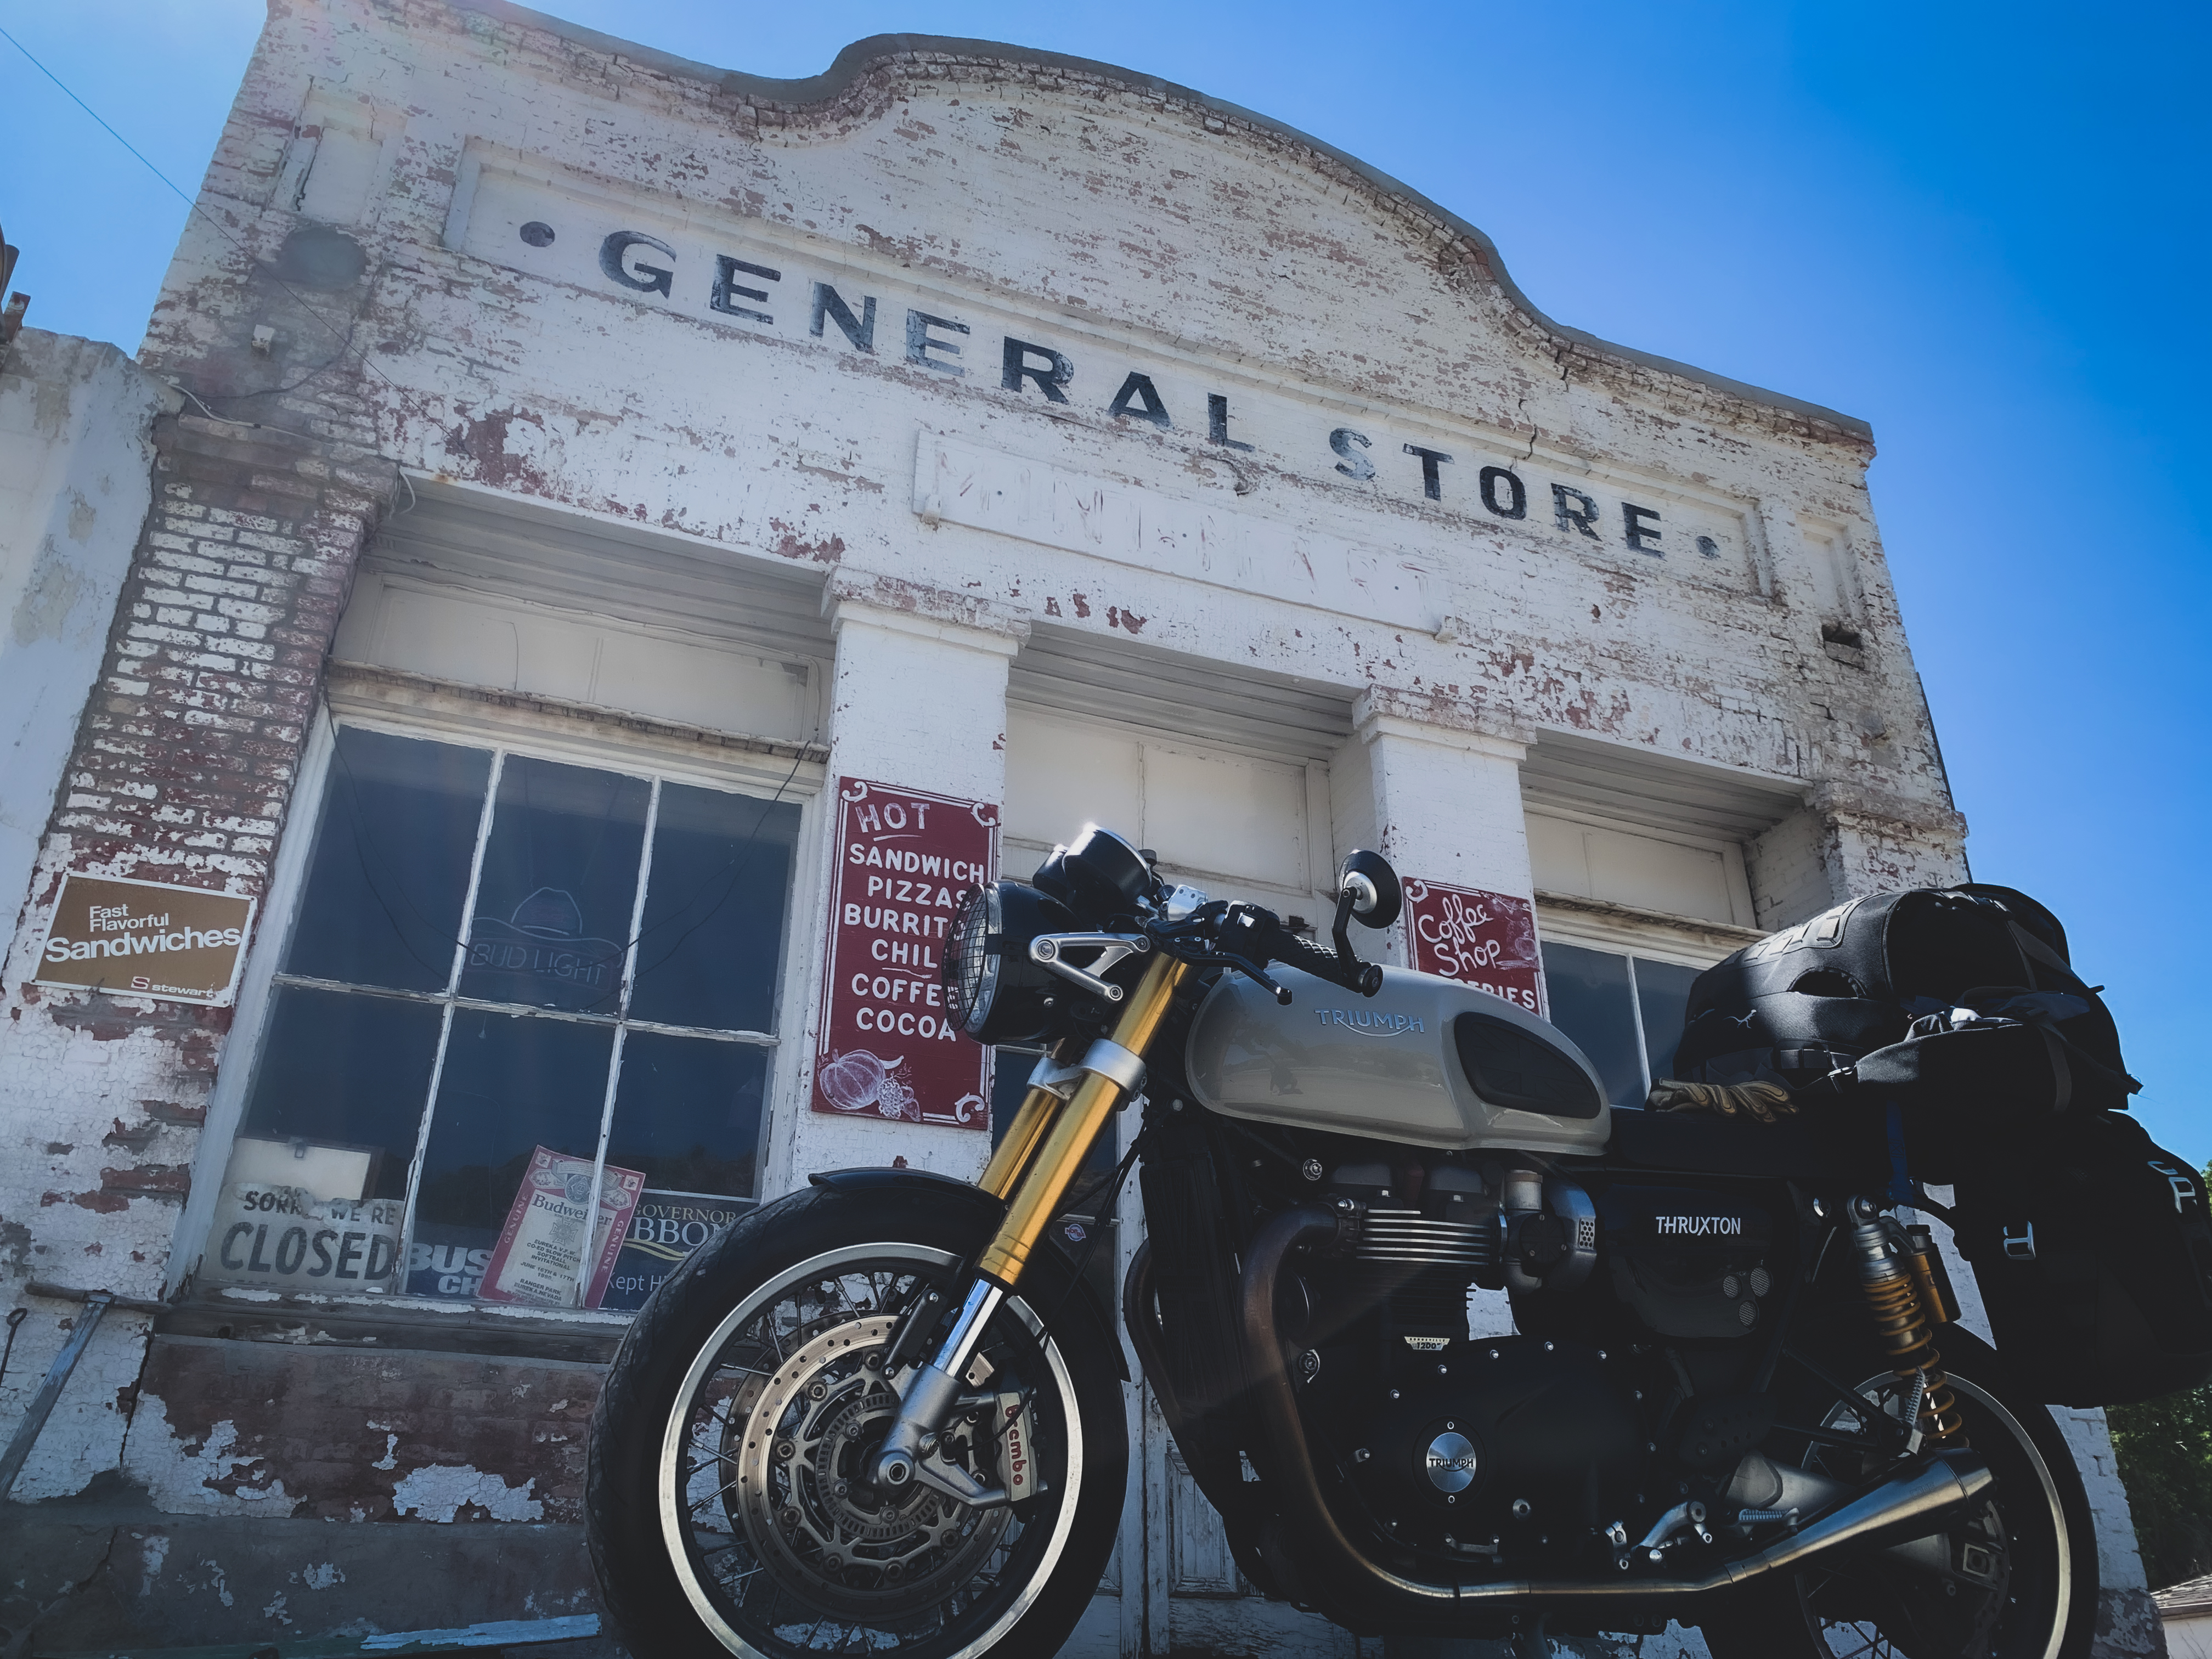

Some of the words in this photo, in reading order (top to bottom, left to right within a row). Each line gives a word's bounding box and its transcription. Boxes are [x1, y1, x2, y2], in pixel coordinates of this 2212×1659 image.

[598, 230, 1256, 453] GENERAL
[1329, 427, 1665, 560] STORE
[854, 802, 930, 833] HOT
[849, 843, 985, 884] SANDWICH
[867, 876, 971, 911] PIZZAS
[89, 904, 129, 919] Fast
[89, 913, 169, 932] Flavorful
[1418, 894, 1493, 945] Coffee
[45, 926, 241, 962] Sandwiches
[871, 939, 947, 970] CHIL
[1434, 936, 1500, 977] Shop
[471, 944, 527, 969] BUD
[533, 949, 606, 985] LIGHT
[851, 973, 959, 1009] COFFEE
[856, 1007, 957, 1042] COCOA
[1314, 1009, 1425, 1037] TRIUMPH
[243, 1190, 302, 1215] SORR
[532, 1193, 612, 1226] Budweier
[504, 1193, 528, 1245] GENUINE
[1656, 1216, 1740, 1235] THRUXTON
[221, 1222, 396, 1280] CLOSED
[527, 1242, 544, 1251] CO-ED
[545, 1248, 562, 1257] SLOW
[563, 1254, 581, 1263] PITCH
[534, 1239, 557, 1250] EUREKA
[537, 1251, 566, 1264] SOFTBALL
[601, 1219, 624, 1273] GENUINE
[521, 1261, 536, 1269] JUNE
[531, 1255, 571, 1271] INVITATIONAL
[520, 1278, 544, 1290] RANGER
[545, 1286, 562, 1295] PARK
[609, 1272, 645, 1295] Kept
[650, 1275, 667, 1291] H
[1429, 1458, 1474, 1471] TRIUMPH
